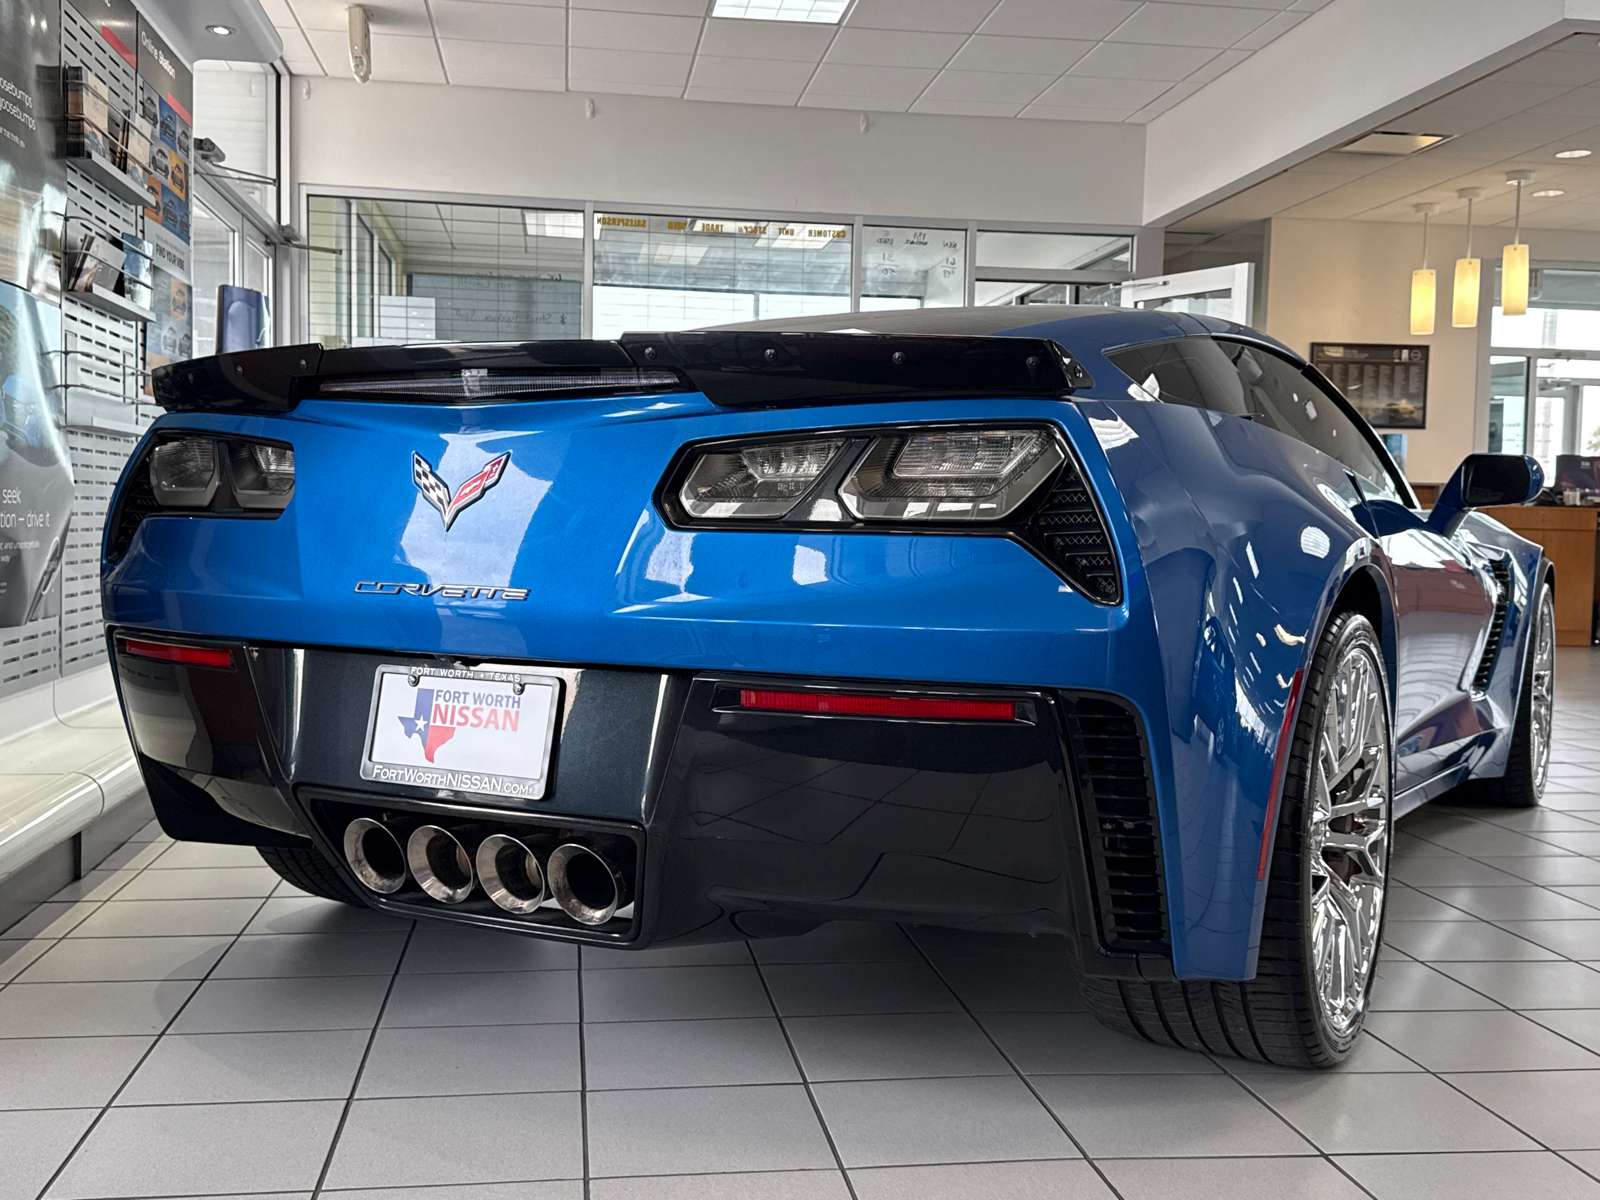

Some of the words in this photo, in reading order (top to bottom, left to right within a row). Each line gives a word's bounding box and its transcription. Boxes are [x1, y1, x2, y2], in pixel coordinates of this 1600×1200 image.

[142, 30, 158, 60] Online
[158, 50, 176, 79] Station
[2, 486, 22, 504] seek
[26, 510, 44, 528] drive
[45, 510, 50, 528] it
[354, 581, 531, 600] CORVETTE
[410, 666, 436, 676] FORT
[440, 669, 474, 679] WORTH
[489, 672, 521, 683] TEXAS
[435, 689, 470, 703] FORT
[473, 694, 521, 709] WORTH
[432, 703, 520, 732] NISSAN
